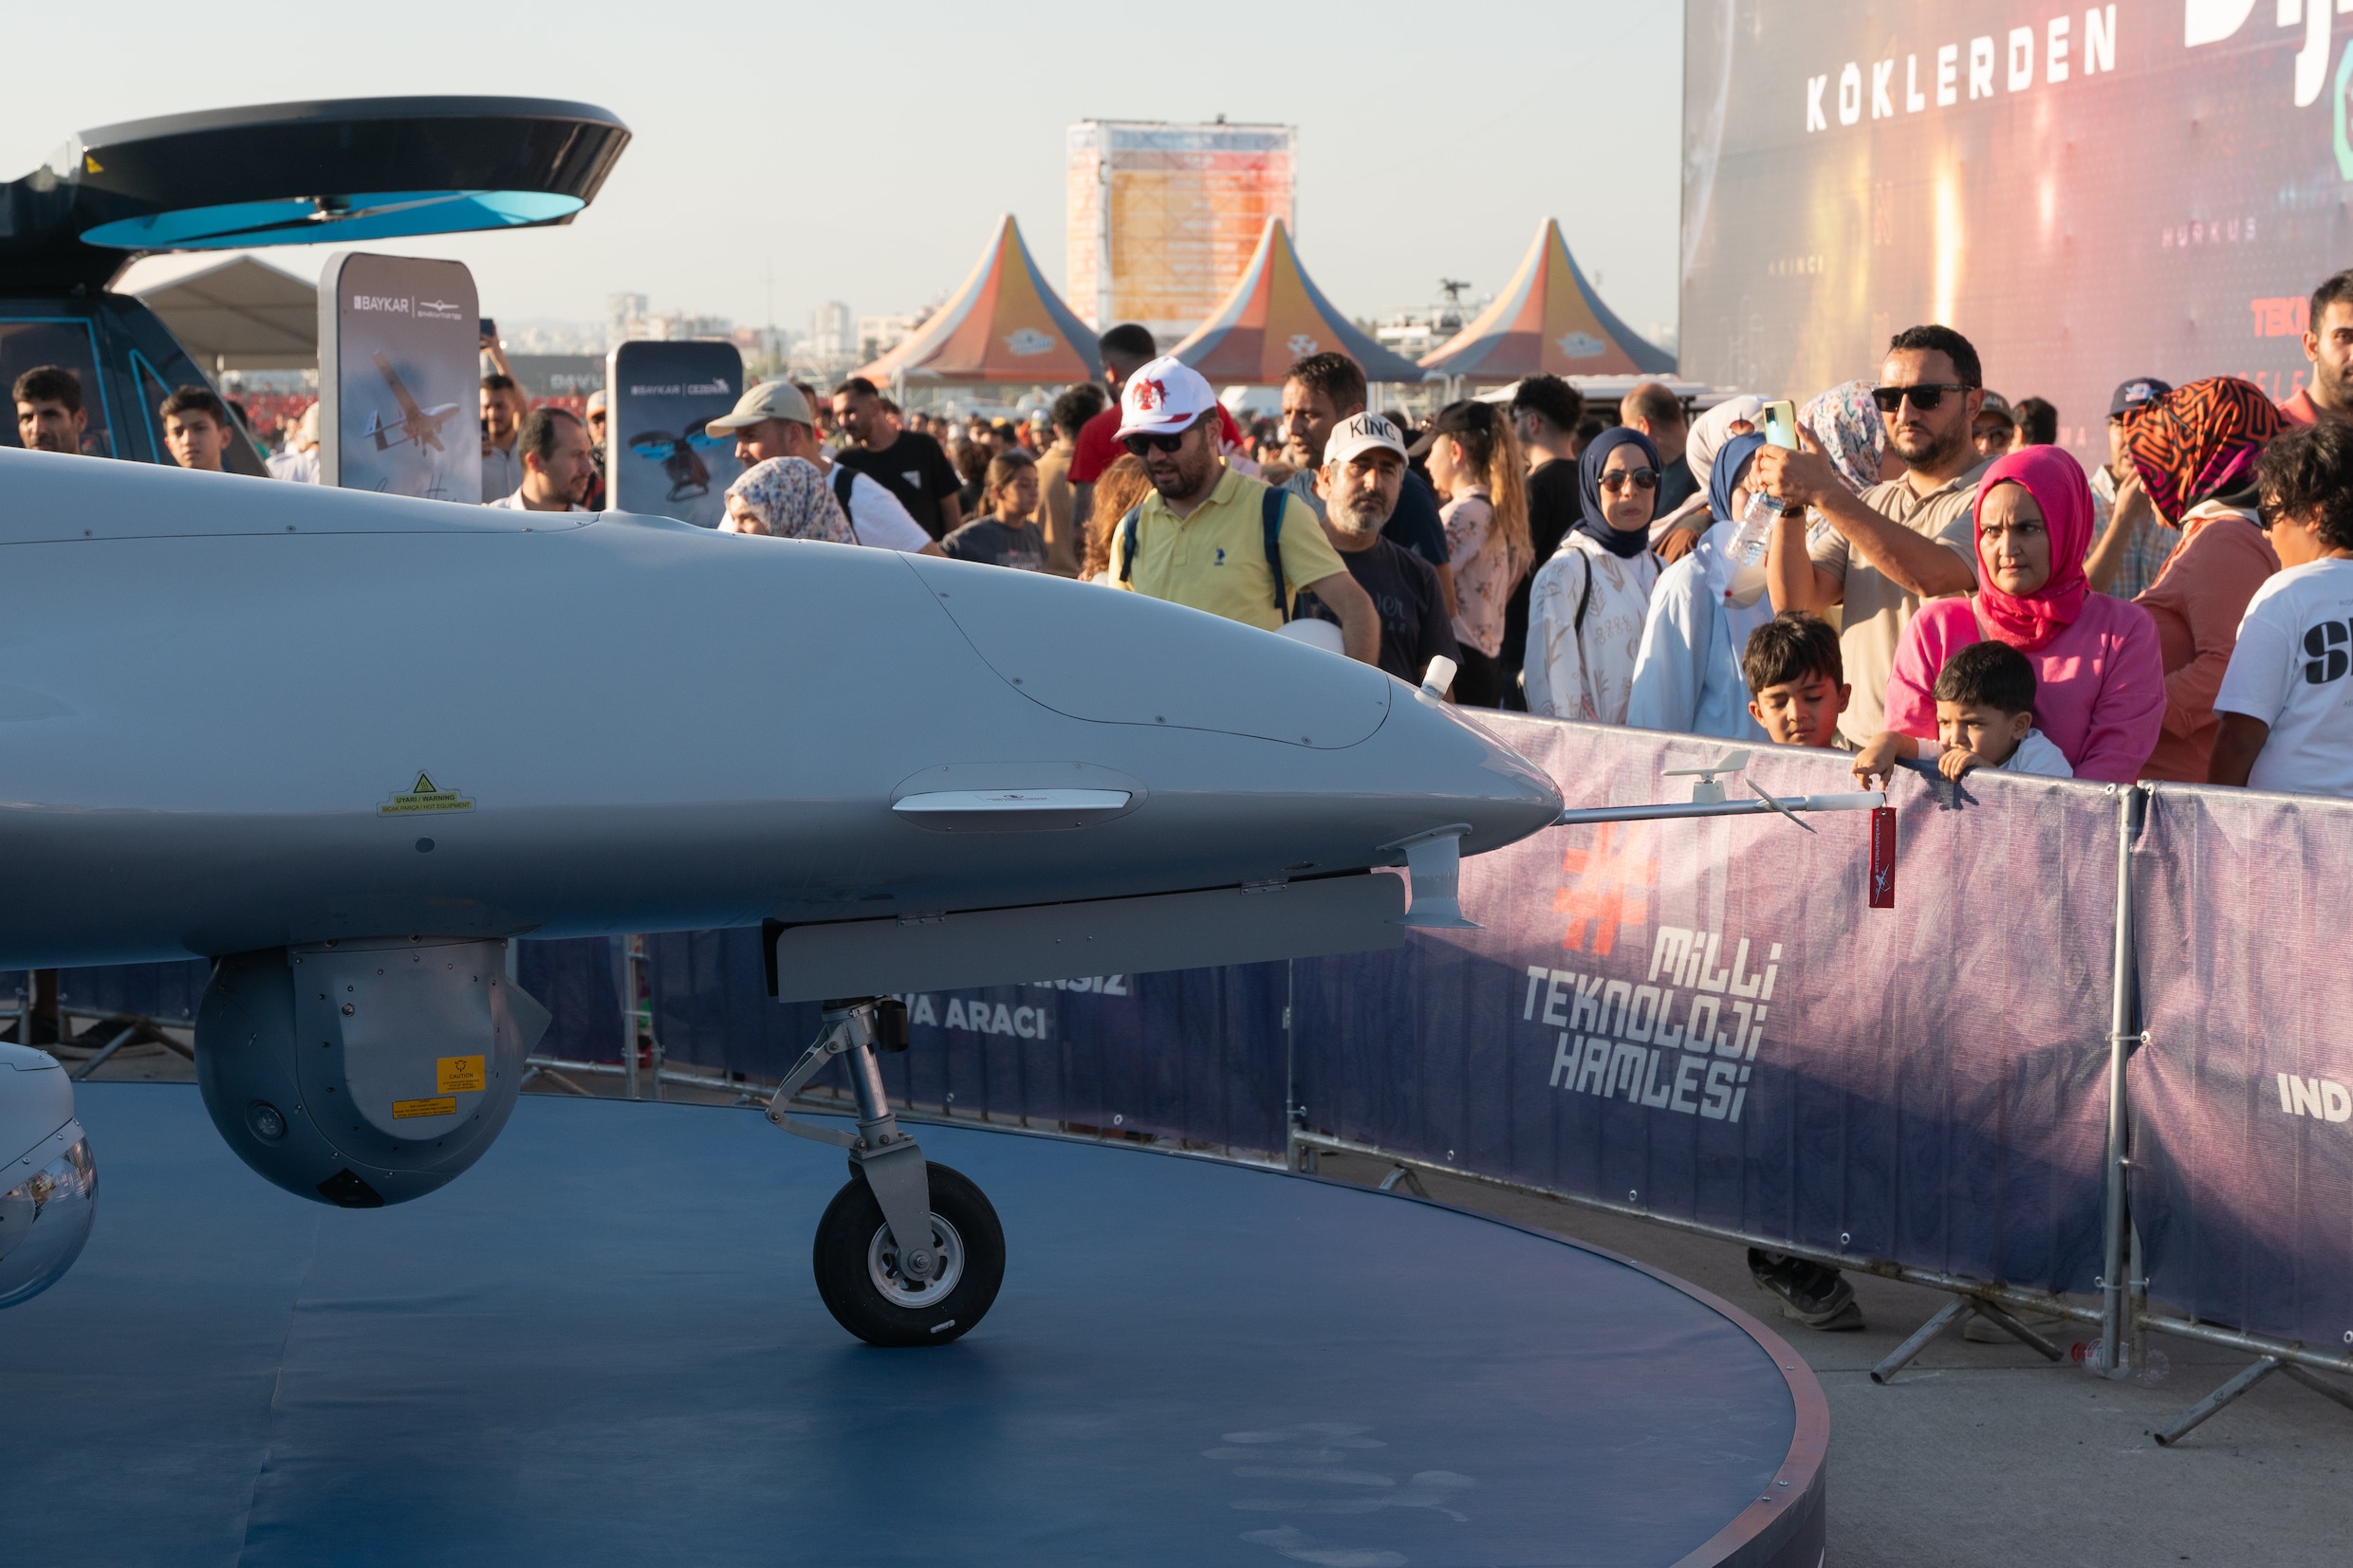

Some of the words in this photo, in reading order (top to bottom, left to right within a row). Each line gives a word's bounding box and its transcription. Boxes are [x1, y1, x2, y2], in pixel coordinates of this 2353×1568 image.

[1806, 3, 2117, 133] KÖKLERDEN
[362, 295, 409, 313] BAYKAR
[1350, 417, 1396, 441] KING
[422, 794, 455, 802] WARNING
[944, 999, 1046, 1040] ARACI
